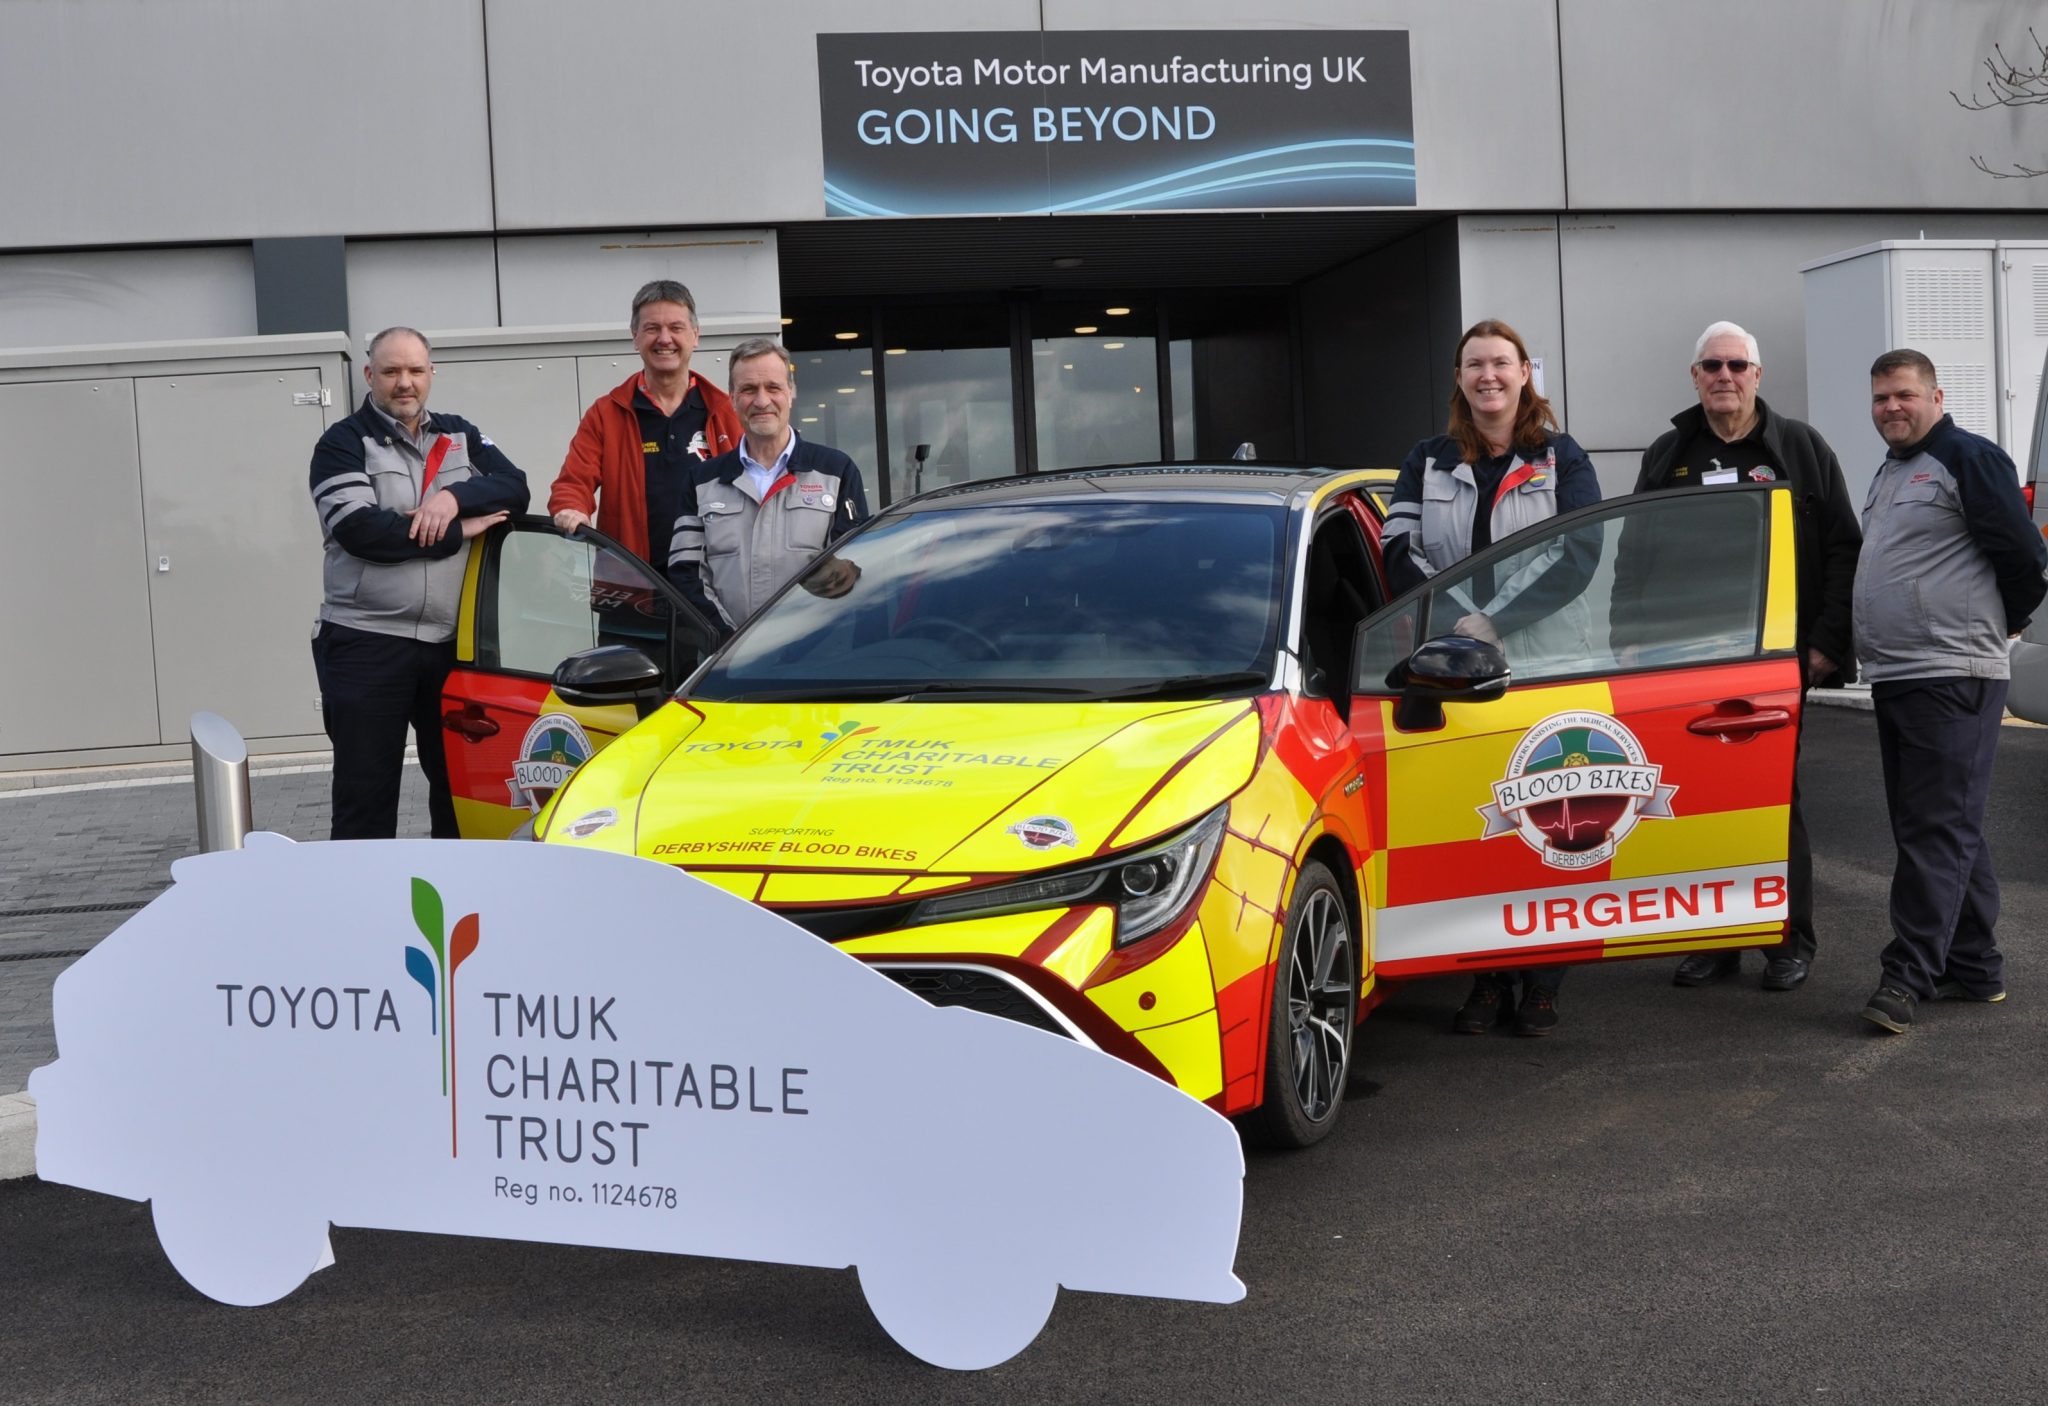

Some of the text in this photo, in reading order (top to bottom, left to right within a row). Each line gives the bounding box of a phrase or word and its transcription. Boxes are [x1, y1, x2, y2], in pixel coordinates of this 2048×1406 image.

[854, 55, 1367, 94] Toyota Motor Manufacturing UK
[857, 105, 1216, 146] GOING BEYOND
[685, 740, 803, 753] TOYOTA
[841, 750, 1063, 770] CHARITABLE
[861, 739, 956, 750] TMUK
[1513, 744, 1531, 775] RIDERS
[1530, 721, 1562, 746] ASSISTING
[1580, 716, 1612, 731] MEDICAL
[1611, 728, 1639, 763] SERVICES
[517, 765, 562, 785] BLOOD
[821, 775, 954, 788] Reg no. 1124678
[830, 763, 944, 776] TRUST
[1498, 769, 1655, 807] BLOOD BIKES
[748, 827, 835, 837] SUPPORTING
[651, 841, 919, 862] DERBYSHIRE BLOOD BIKES
[1552, 846, 1606, 866] DERBYSHIRE
[1502, 875, 1787, 937] URGENT B
[216, 983, 401, 1033] TOYOTA
[483, 992, 618, 1042] TMUK
[486, 1053, 809, 1115] CHARITABLE
[485, 1114, 650, 1167] TRUST
[494, 1176, 678, 1210] Reg no. 1124678
